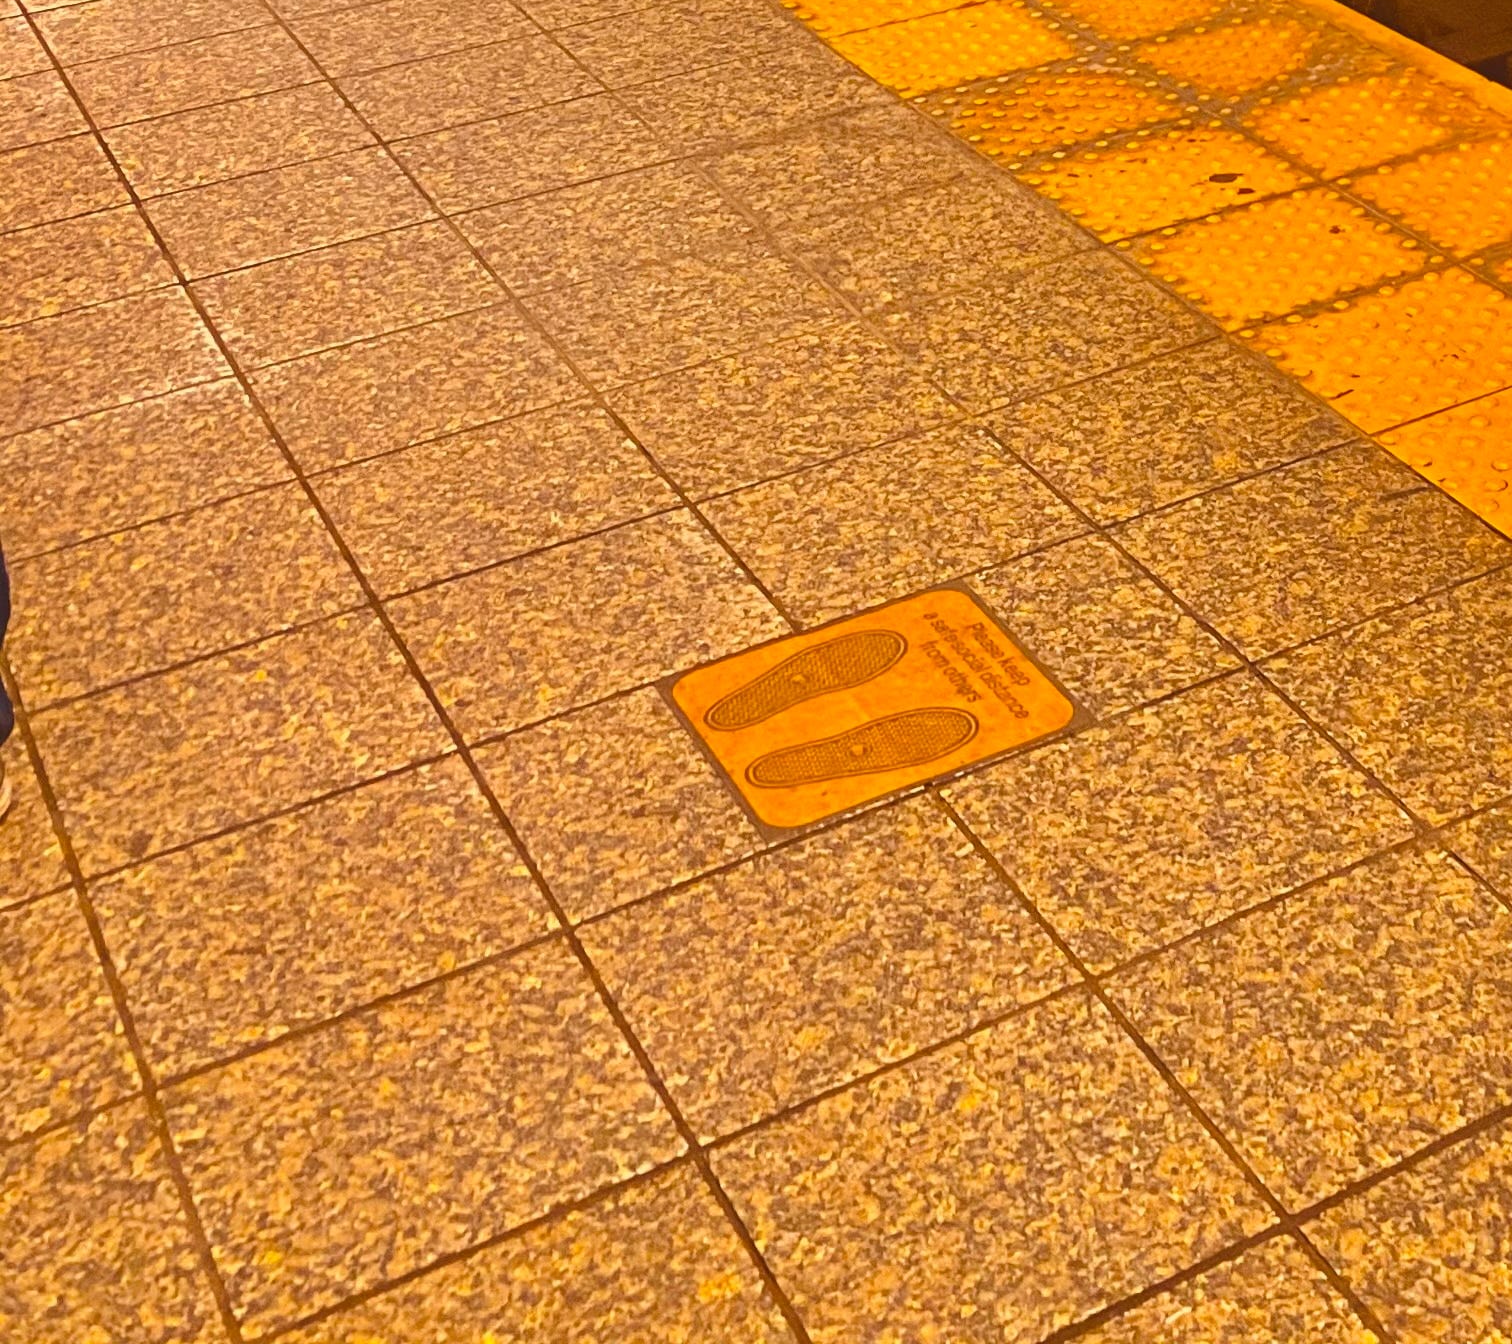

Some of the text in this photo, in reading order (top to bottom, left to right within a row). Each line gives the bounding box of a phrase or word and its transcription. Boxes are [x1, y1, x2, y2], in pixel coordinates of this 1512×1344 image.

[923, 612, 939, 620] a
[930, 619, 960, 643] safe
[919, 640, 983, 703] from others
[964, 622, 1031, 686] Please keep
[979, 672, 1030, 719] distance
